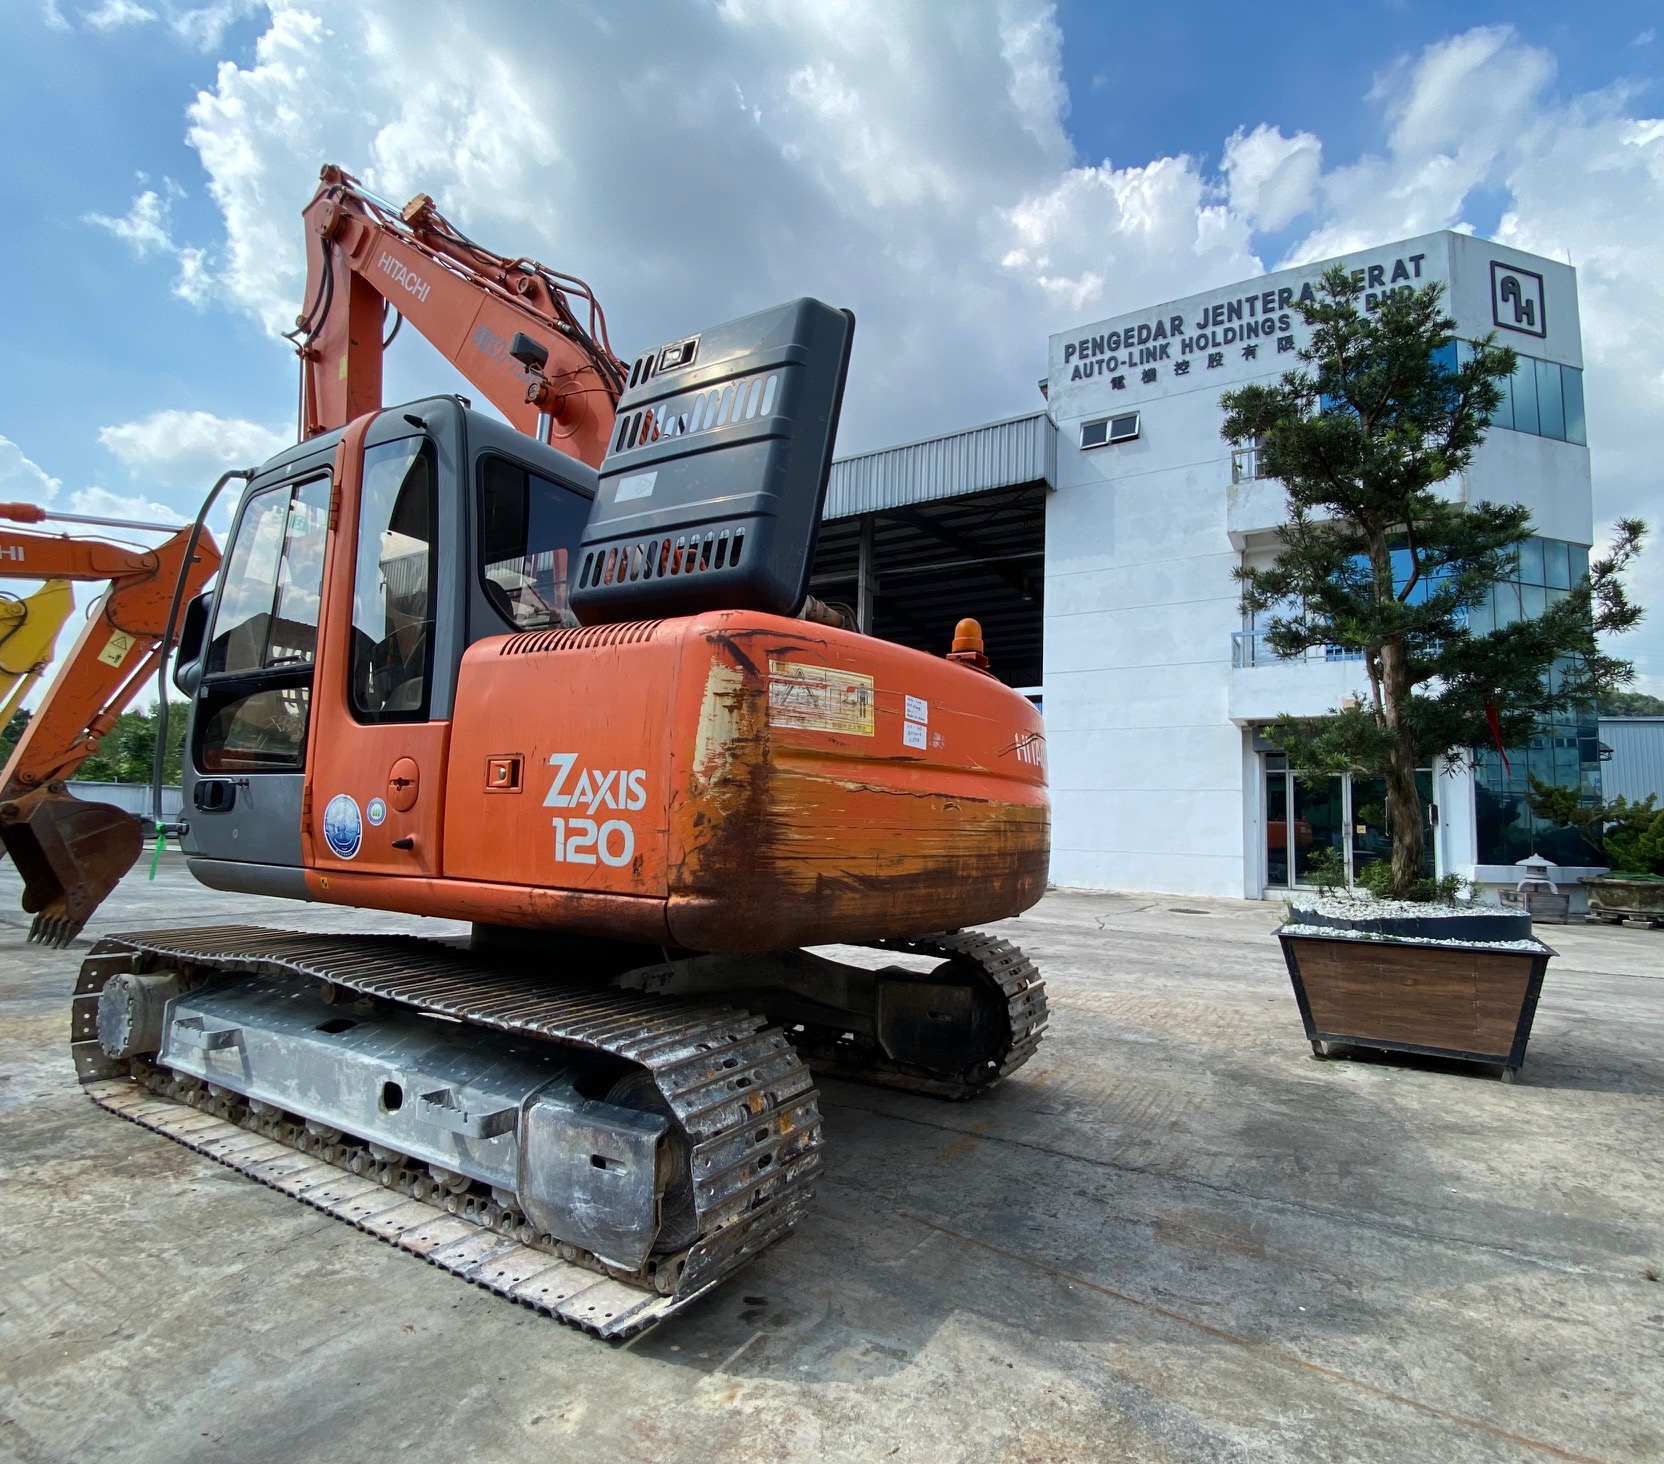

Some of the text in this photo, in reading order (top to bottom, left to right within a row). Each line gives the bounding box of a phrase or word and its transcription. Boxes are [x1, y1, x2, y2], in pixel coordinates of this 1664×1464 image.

[378, 251, 431, 303] HITACHI
[1064, 315, 1184, 364] PENGEDAR
[1196, 282, 1316, 330] JENTERA
[1070, 342, 1171, 382] AUTO-LINK
[1181, 313, 1291, 355] HOLDINGS
[1013, 732, 1047, 770] HITA
[542, 752, 647, 815] ZAXIS
[552, 817, 635, 867] 120
